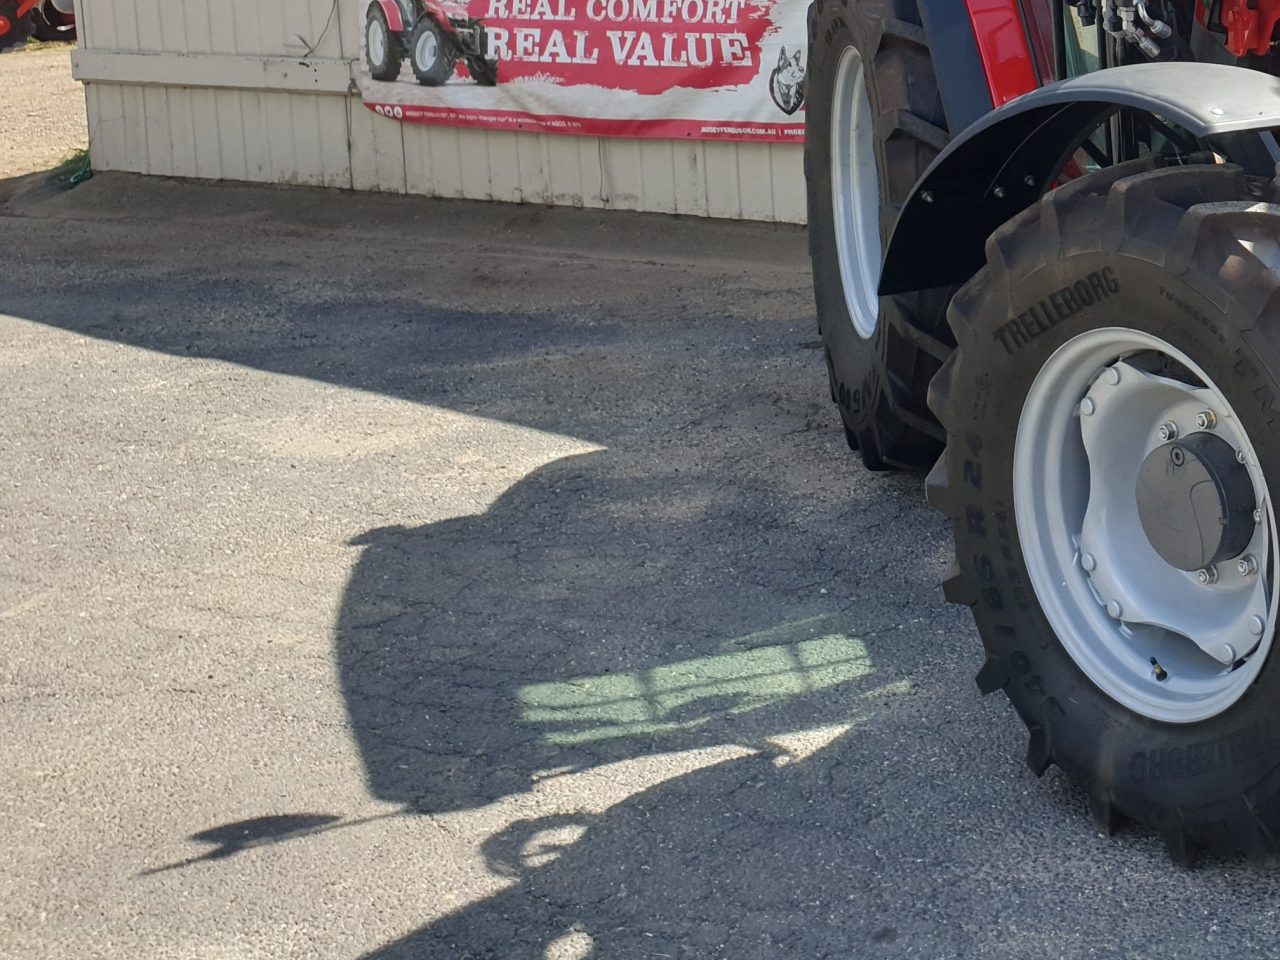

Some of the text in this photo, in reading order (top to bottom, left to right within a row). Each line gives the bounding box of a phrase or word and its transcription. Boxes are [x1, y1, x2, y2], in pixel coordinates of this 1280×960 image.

[485, 26, 752, 67] REAL VALUE
[992, 266, 1121, 355] TRELLEBORG
